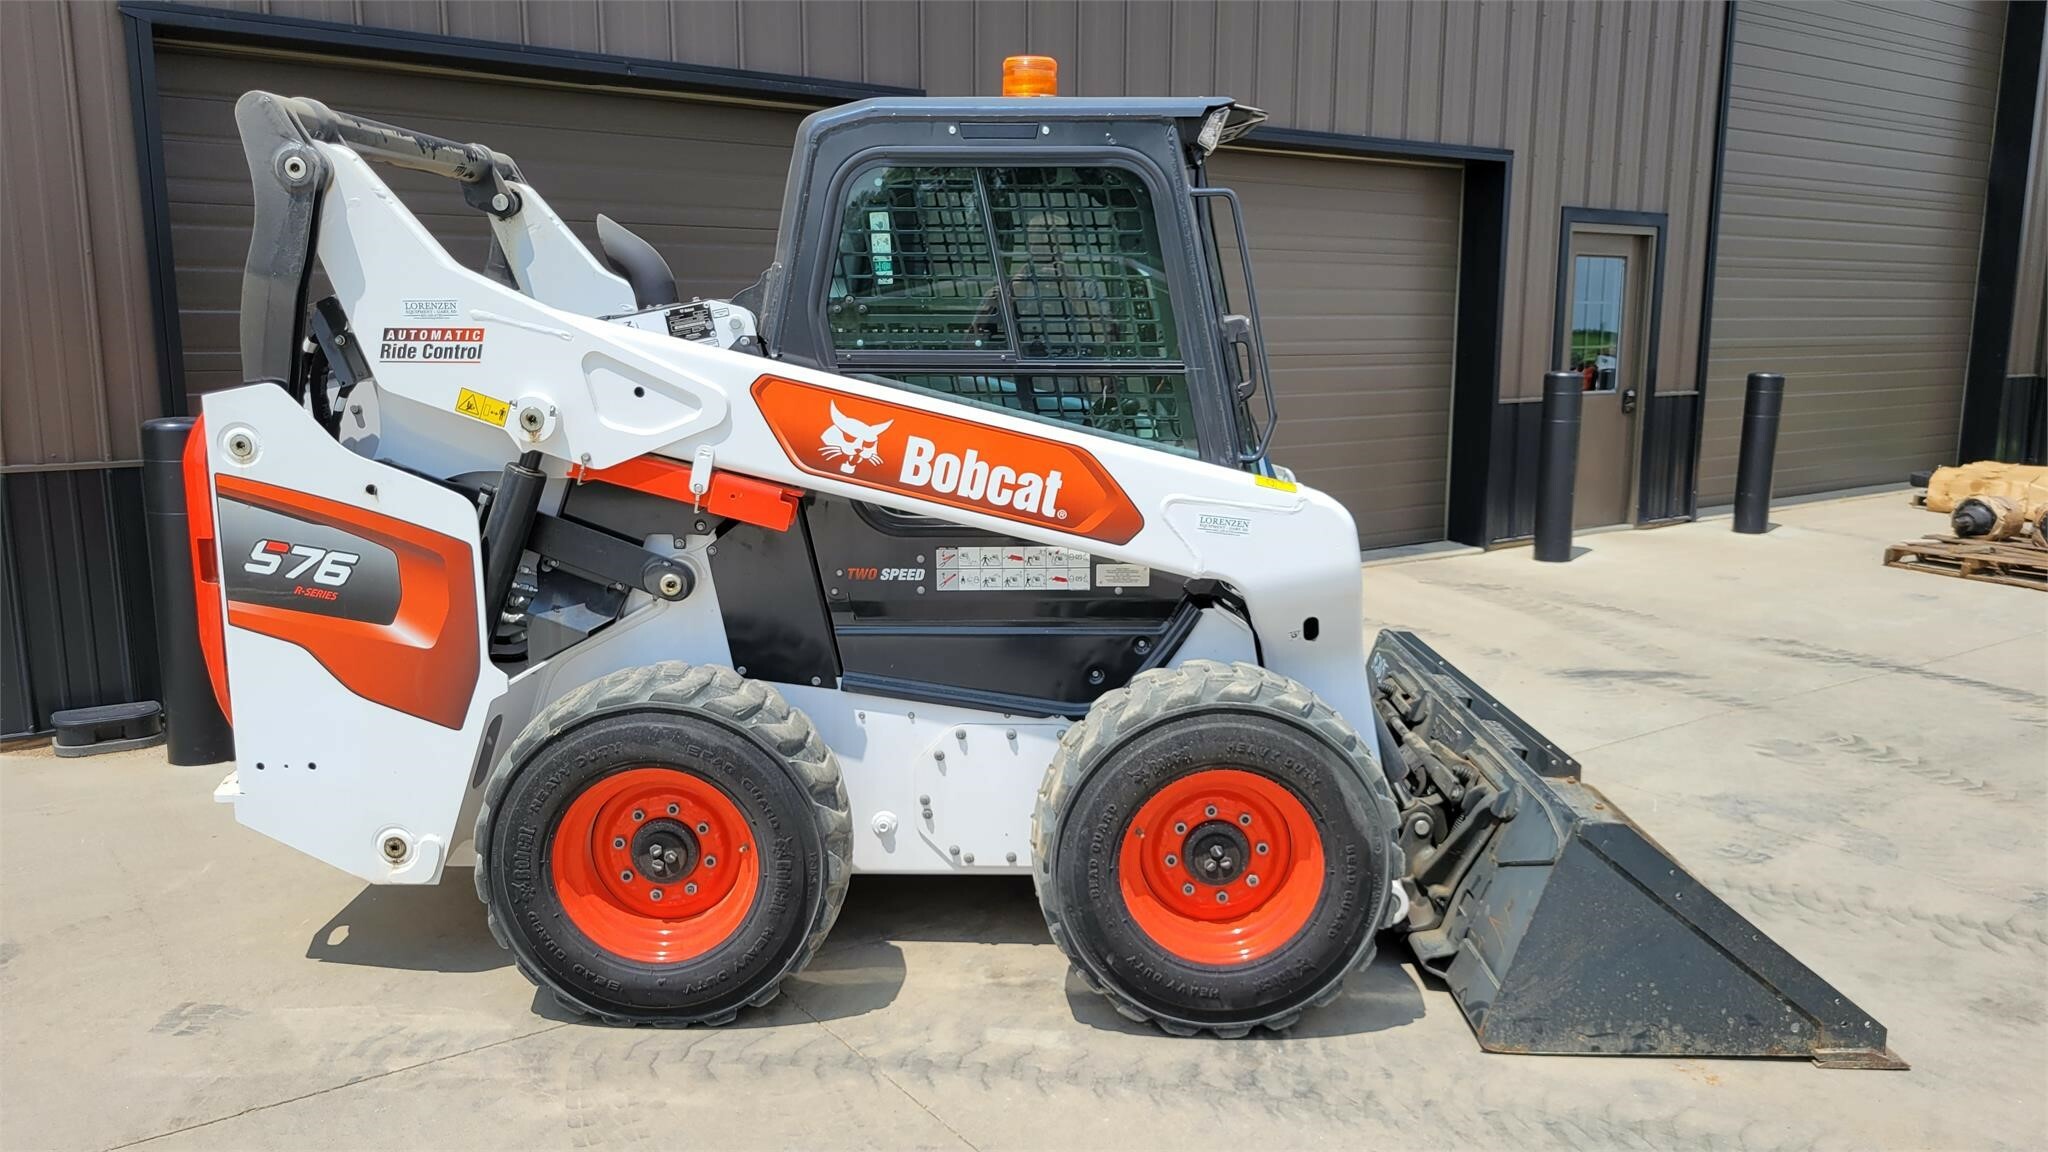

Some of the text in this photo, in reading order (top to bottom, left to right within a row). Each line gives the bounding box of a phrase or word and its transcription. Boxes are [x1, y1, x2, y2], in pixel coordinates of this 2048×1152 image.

[405, 302, 457, 310] LORENZEN
[386, 330, 481, 341] AUTOMATIC
[380, 343, 483, 359] Ride Control
[900, 435, 1064, 518] Bobcat
[1200, 516, 1249, 528] LORENZEN
[243, 538, 360, 587] S76
[847, 567, 926, 582] TWO SPEED
[294, 586, 340, 601] R-SERIES
